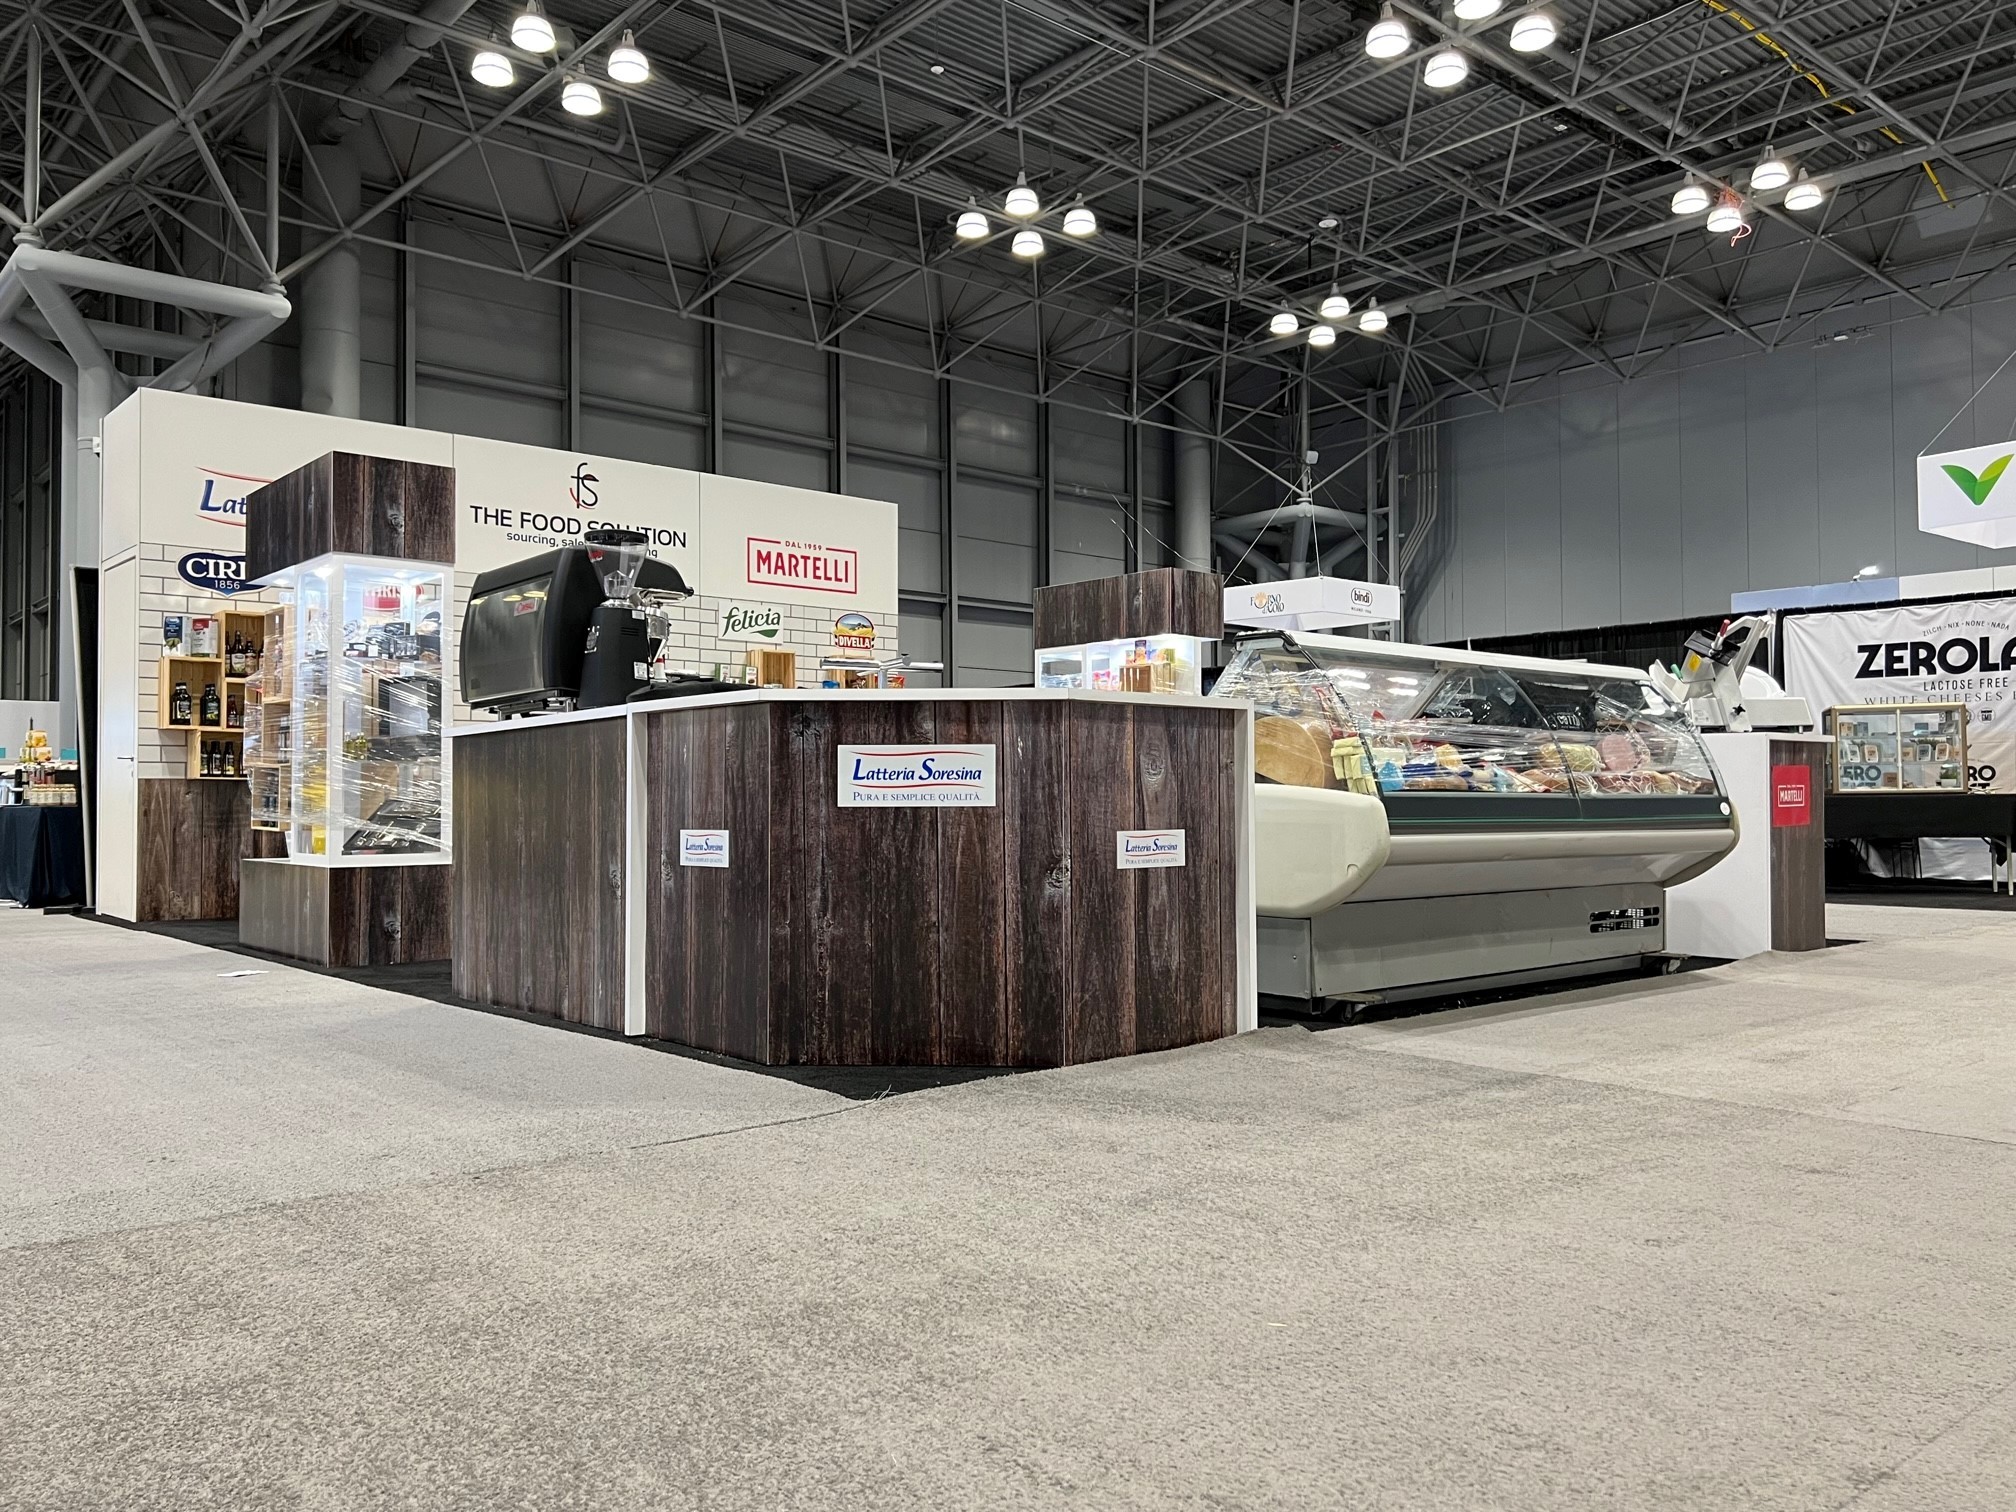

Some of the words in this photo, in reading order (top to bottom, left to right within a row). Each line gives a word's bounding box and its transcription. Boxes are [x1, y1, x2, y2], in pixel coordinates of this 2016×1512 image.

[200, 479, 247, 515] Lat
[470, 505, 513, 528] THE
[520, 511, 581, 535] FOOD
[587, 520, 687, 548] STION
[506, 531, 559, 548] sourcing,
[561, 538, 585, 548] sale
[785, 540, 802, 549] DAL
[803, 543, 822, 551] 1959
[185, 558, 246, 581] CIRI
[756, 549, 849, 583] MARTELLI
[214, 579, 240, 590] 1856
[1354, 589, 1370, 604] bindi
[721, 606, 781, 638] felicia
[1922, 625, 1942, 637] ZILCH
[1947, 621, 1960, 629] NIX
[1990, 621, 2010, 631] NADA
[838, 635, 871, 649] DIVELLA
[1923, 678, 1973, 692] LACTOSE
[1979, 677, 2009, 689] FREE
[1864, 695, 1918, 705] WHITE
[1927, 691, 2003, 703] CHEESES
[853, 758, 915, 781] Latteria
[918, 758, 982, 781] Soresina
[1967, 765, 1997, 781] RO
[882, 793, 889, 801] E
[1779, 790, 1803, 802] MARTELLI
[1125, 839, 1152, 853] Latteria
[1152, 838, 1178, 852] Soresina
